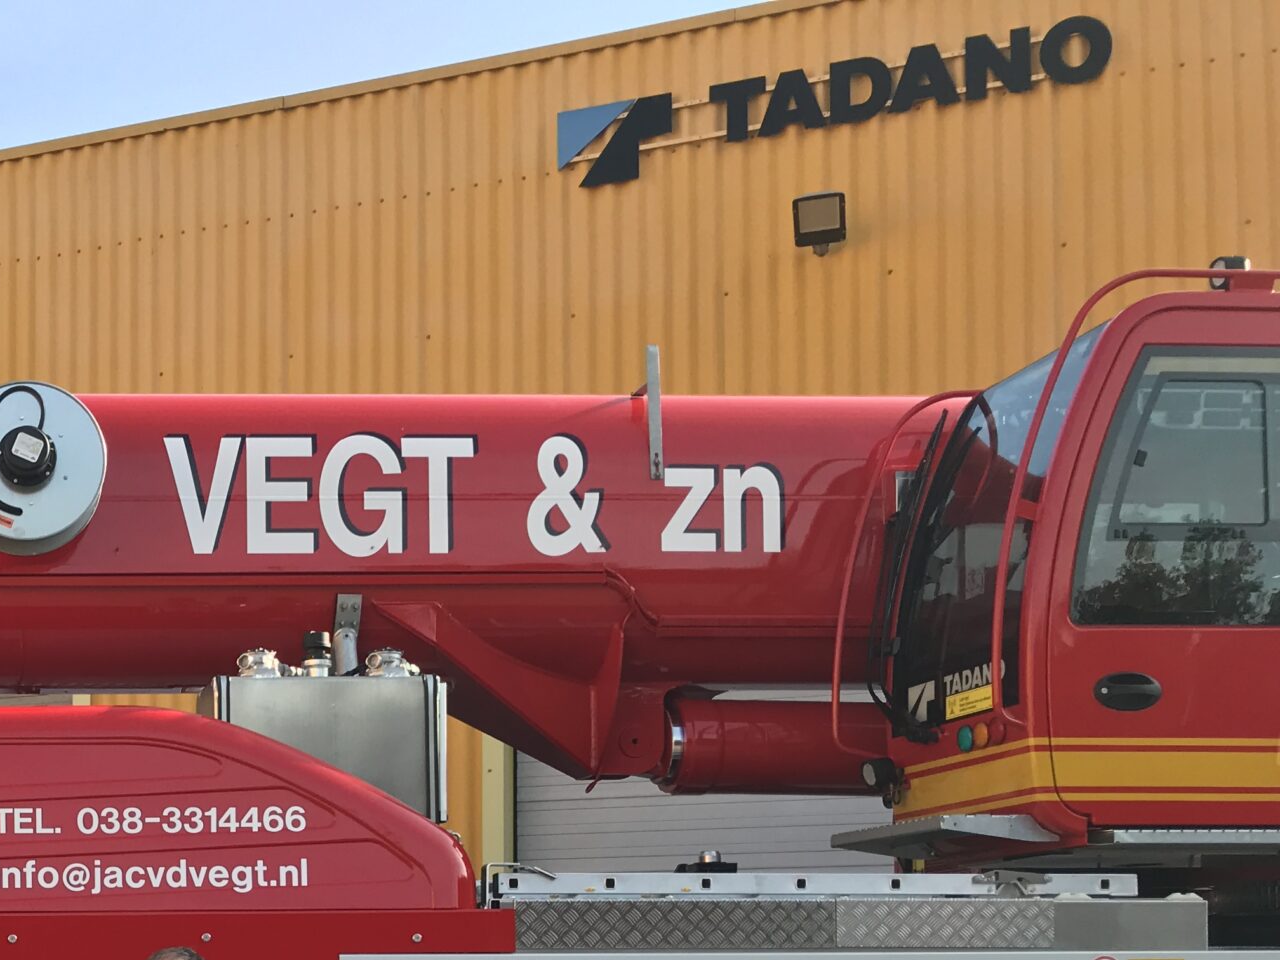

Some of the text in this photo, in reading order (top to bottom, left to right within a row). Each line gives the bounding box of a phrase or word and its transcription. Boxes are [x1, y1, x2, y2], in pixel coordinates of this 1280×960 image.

[708, 15, 1113, 143] TADANO
[163, 434, 477, 557] VEGT
[527, 434, 606, 557] &
[660, 463, 786, 553] zn
[76, 805, 307, 834] 038-3314466
